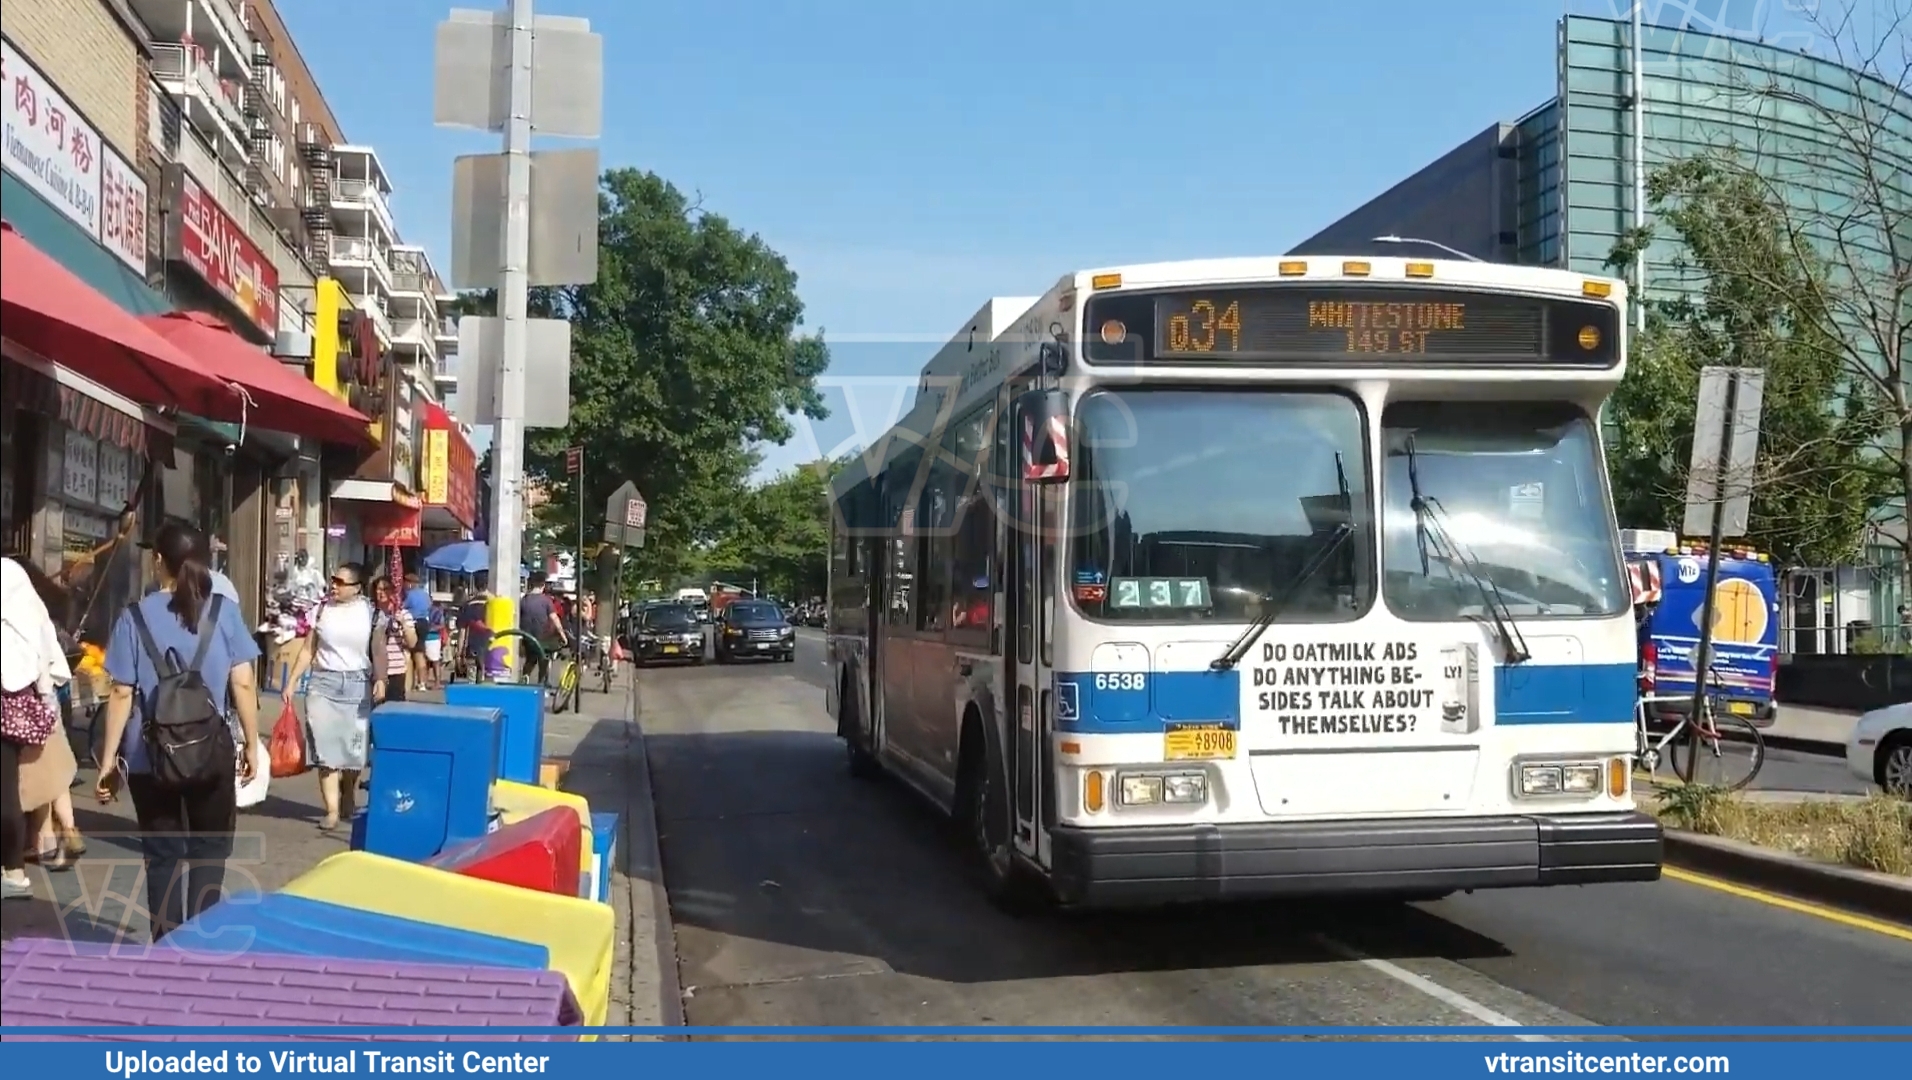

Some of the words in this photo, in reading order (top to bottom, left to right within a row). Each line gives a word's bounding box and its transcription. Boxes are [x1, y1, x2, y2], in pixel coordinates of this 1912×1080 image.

[6, 122, 45, 179] Vietnamese
[45, 157, 68, 199] Cuisine
[1170, 300, 1240, 351] Q34
[1309, 301, 1465, 329] WHITESTONE
[1346, 330, 1389, 353] 149
[1399, 330, 1430, 353] ST
[1117, 579, 1202, 606] 237
[1263, 643, 1286, 662] DO
[1292, 642, 1376, 662] OATMILK
[1382, 642, 1417, 661] ADS
[1095, 673, 1145, 690] 6538
[1253, 667, 1277, 687] DO
[1283, 666, 1386, 686] ANYTHING
[1391, 665, 1423, 684] BE-
[1258, 691, 1313, 711] SIDES
[1318, 690, 1366, 710] TALK
[1372, 688, 1434, 709] ABOUT
[1278, 714, 1418, 735] THEMSELVES?
[1203, 731, 1233, 751] 8908
